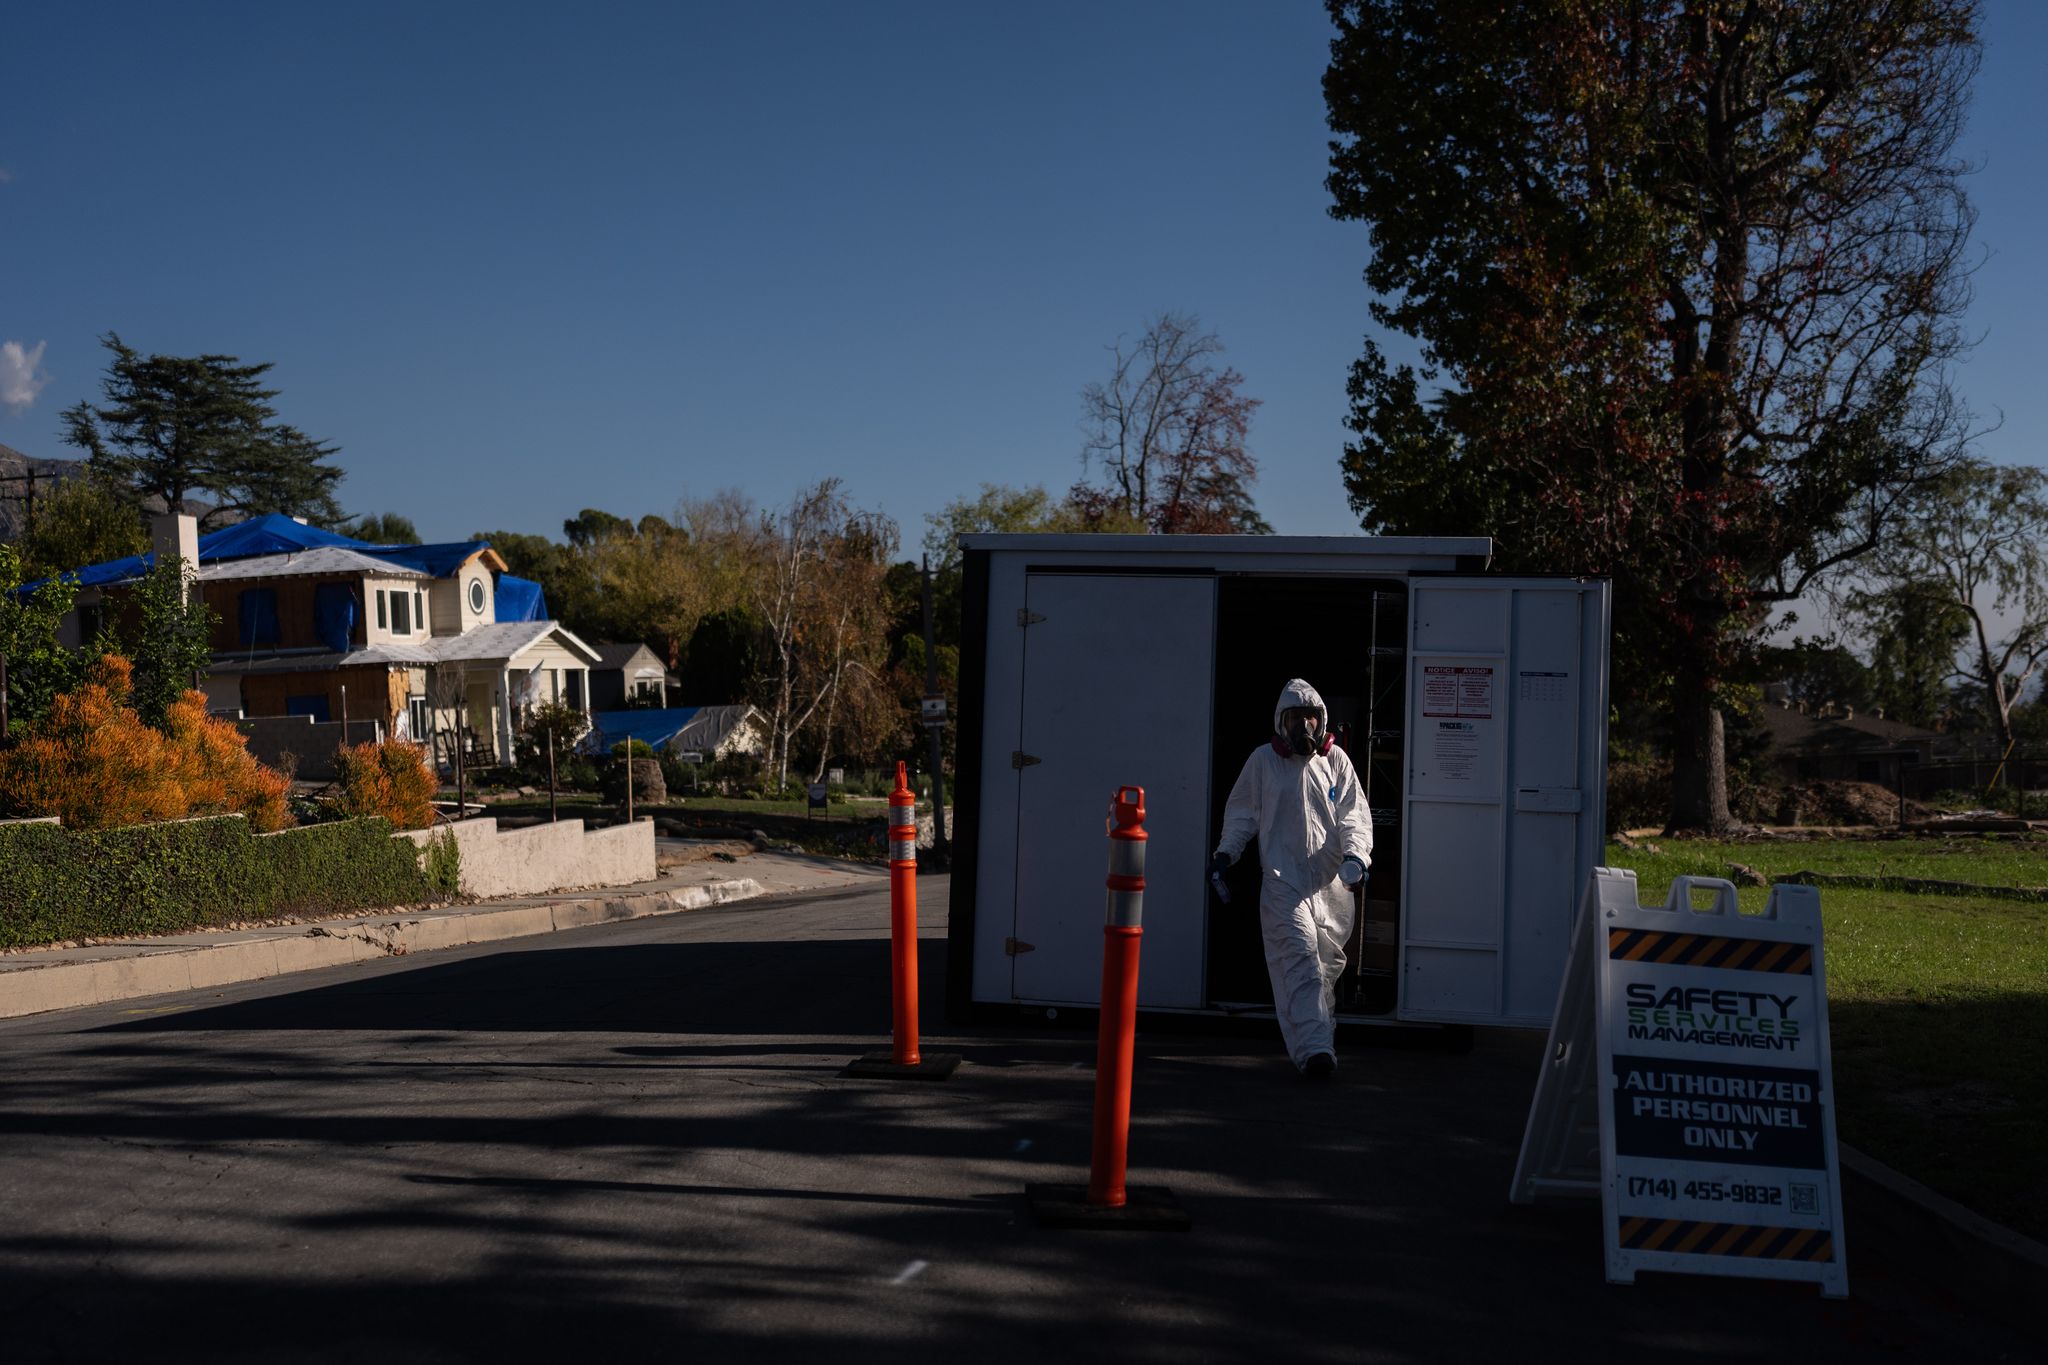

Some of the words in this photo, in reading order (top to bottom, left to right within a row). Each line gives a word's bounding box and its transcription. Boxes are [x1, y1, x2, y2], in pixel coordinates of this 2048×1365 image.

[1626, 984, 1798, 1019] SAFETY
[1628, 1009, 1799, 1035] SERVICES
[1628, 1026, 1800, 1051] MANAGEMENT
[1624, 1071, 1812, 1103] AUTHORIZED
[1632, 1097, 1807, 1128] PERSONNEL
[1683, 1126, 1759, 1151] ONLY
[1629, 1177, 1677, 1200] (714)
[1684, 1181, 1782, 1205] 455-9832
